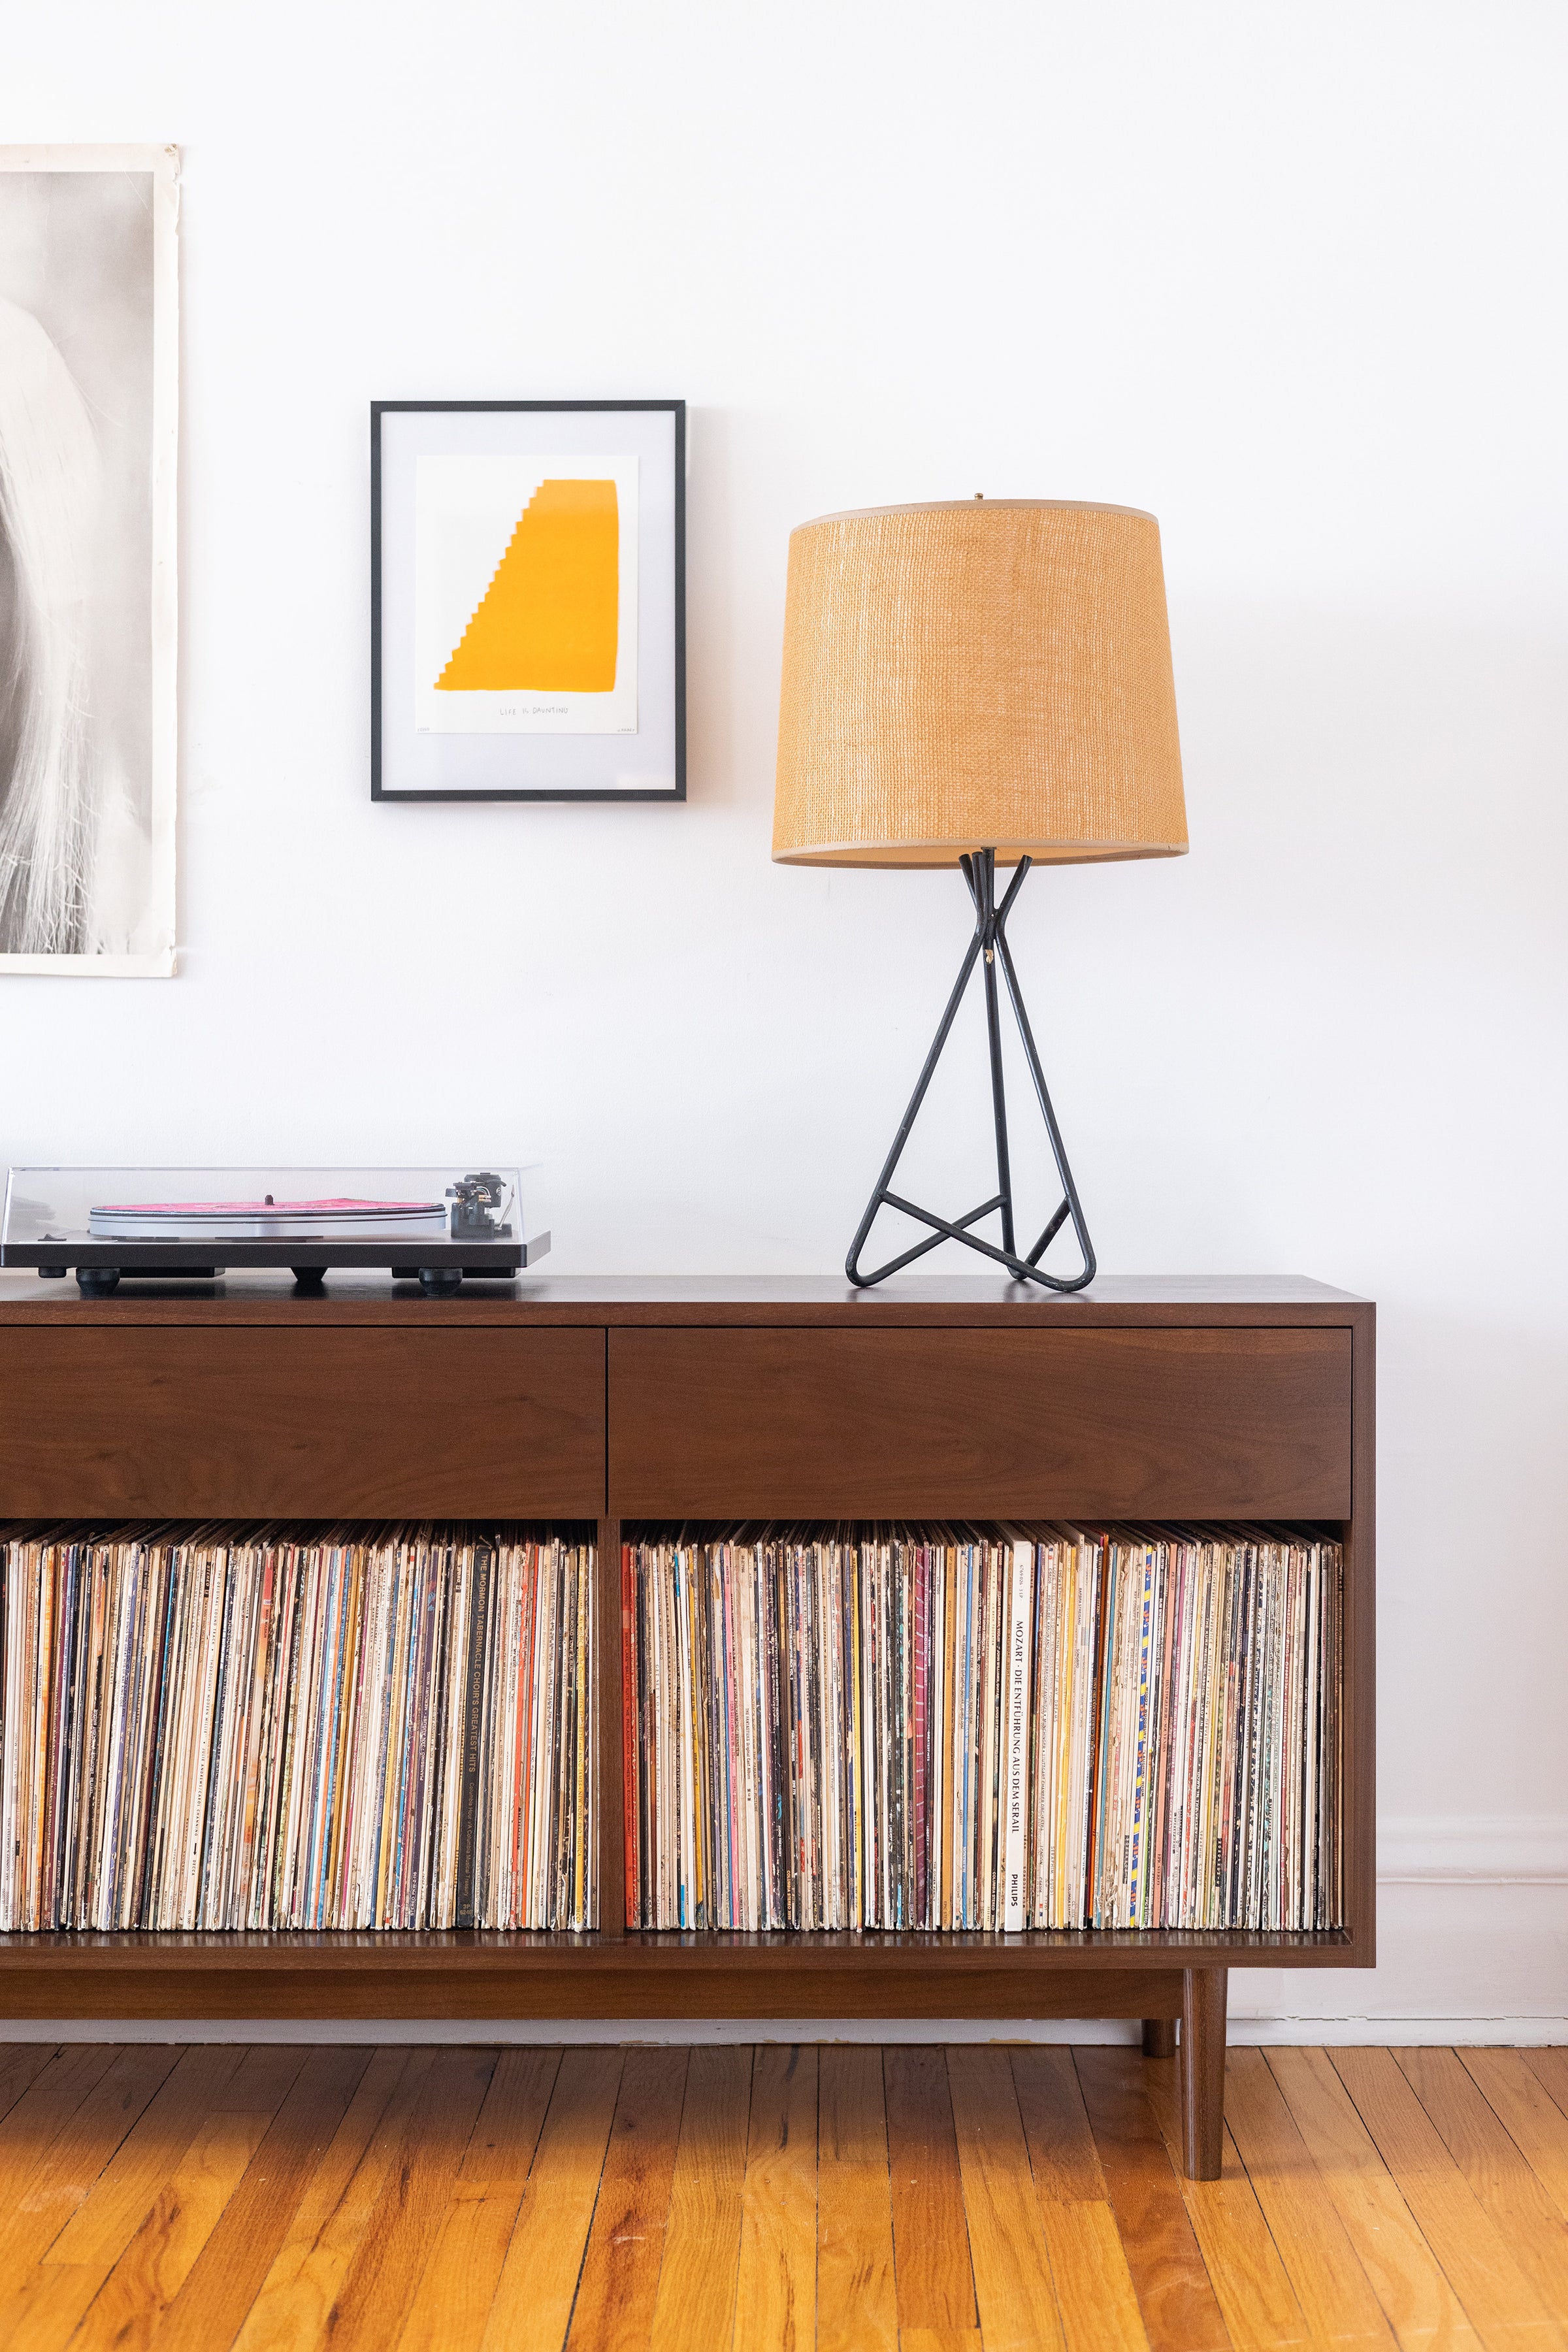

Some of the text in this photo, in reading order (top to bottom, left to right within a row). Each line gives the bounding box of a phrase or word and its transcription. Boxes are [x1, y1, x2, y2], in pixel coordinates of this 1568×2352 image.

[478, 1573, 486, 1611] MORMON
[474, 1614, 484, 1669] TABERNACLE
[1015, 1620, 1023, 1662] MOZART
[471, 1671, 480, 1705] CHOIR'S
[469, 1707, 478, 1750] GREATEST
[1012, 1688, 1023, 1754] ENTFÜHRUNG
[468, 1753, 476, 1772] HITS
[1011, 1758, 1020, 1776] AUS
[1011, 1802, 1019, 1834] SERAIL
[1010, 1874, 1019, 1906] PHILIPS
